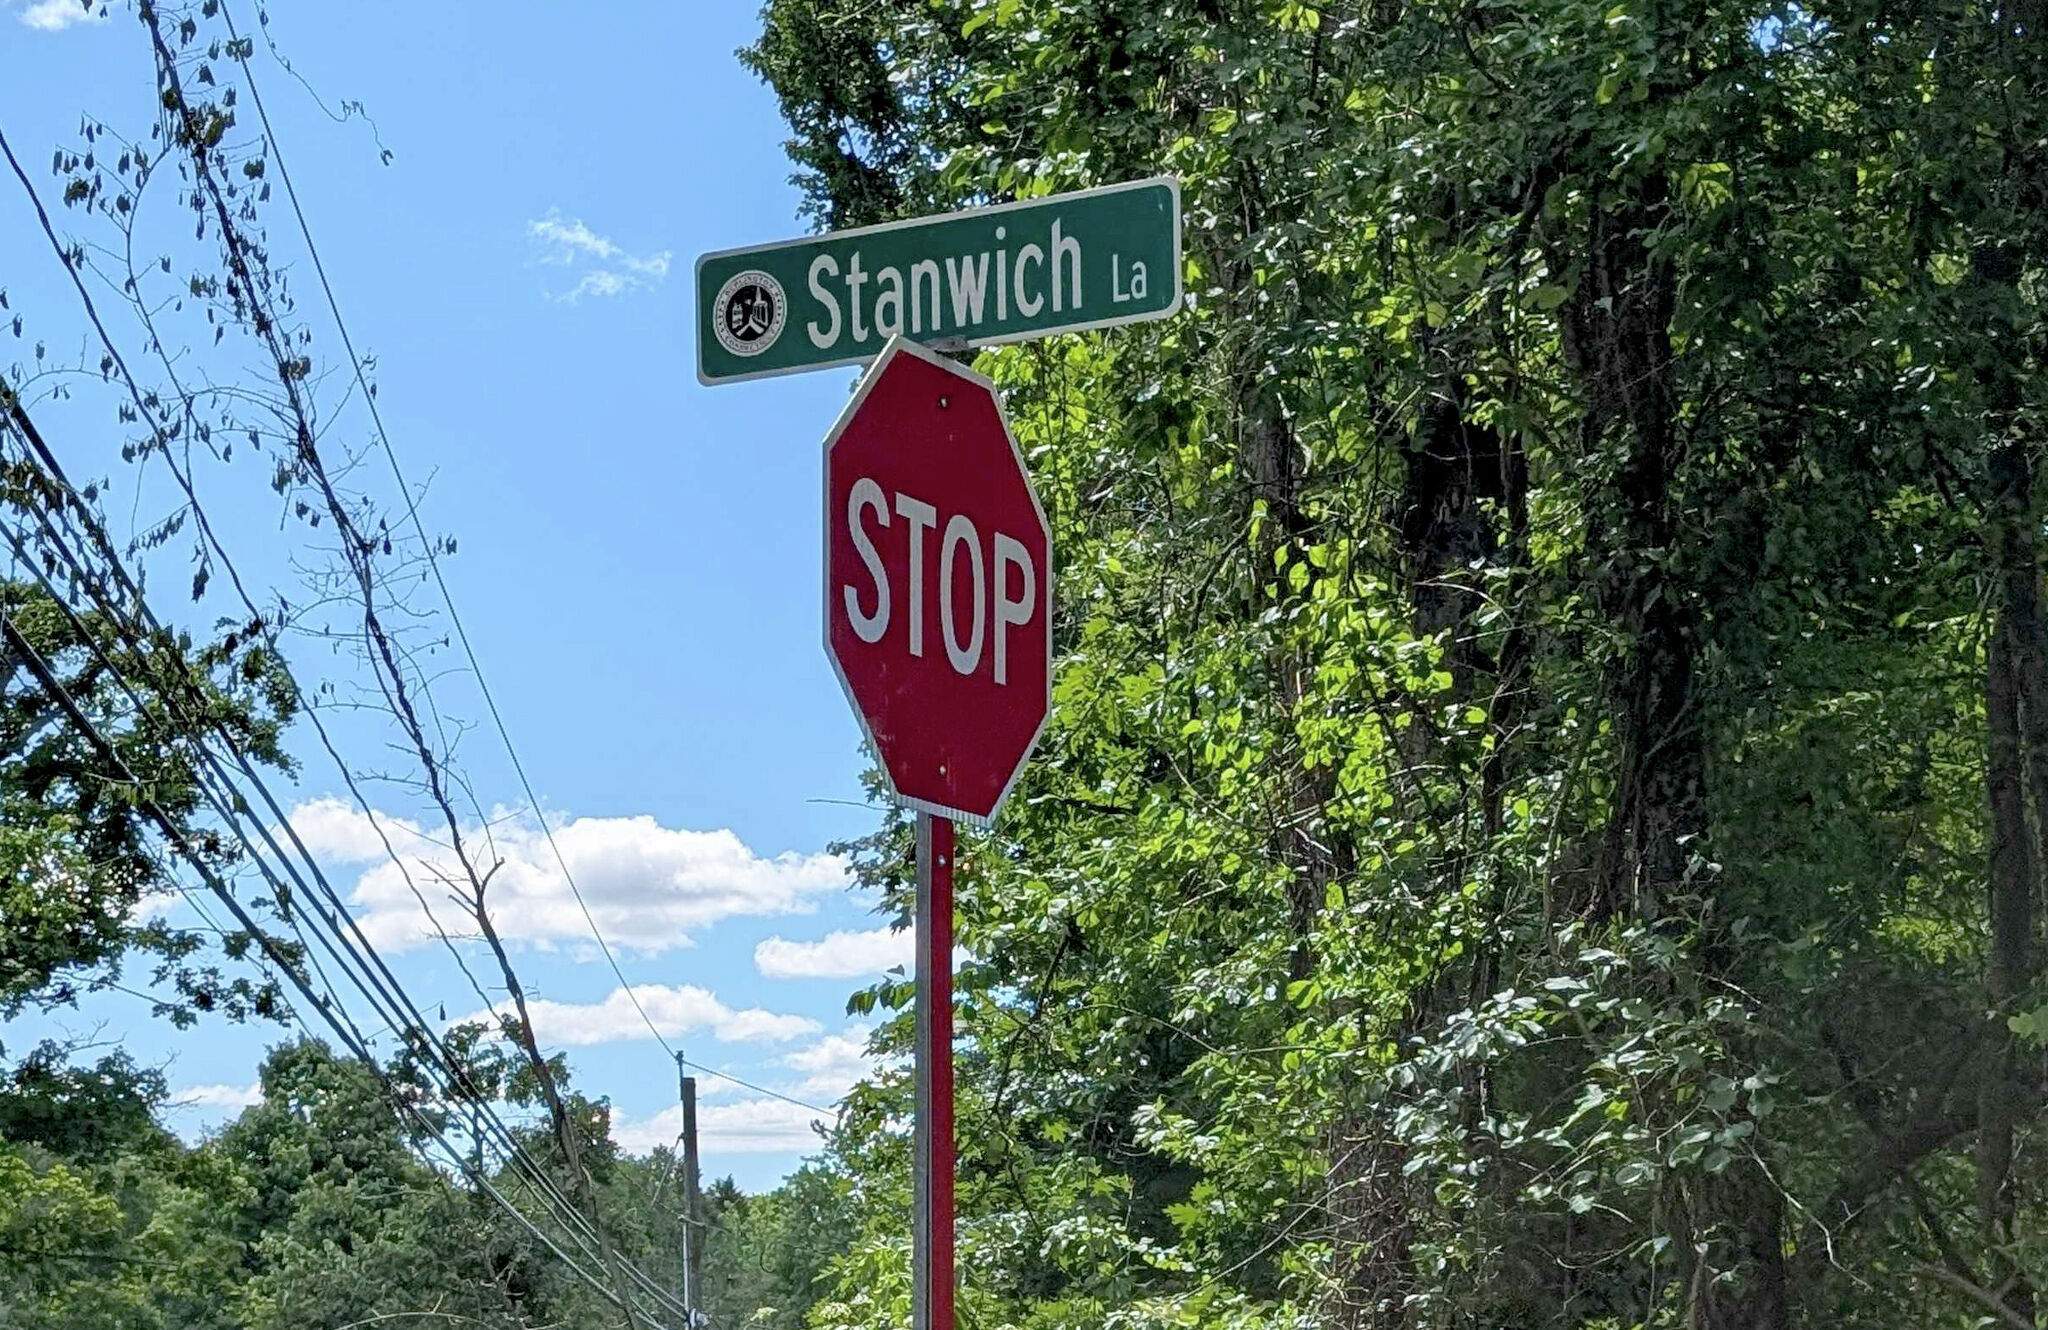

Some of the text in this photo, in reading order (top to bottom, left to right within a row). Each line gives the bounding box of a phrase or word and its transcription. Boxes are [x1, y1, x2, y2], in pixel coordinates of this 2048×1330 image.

[807, 217, 1148, 350] Stanwich La
[843, 477, 1036, 685] STOP
